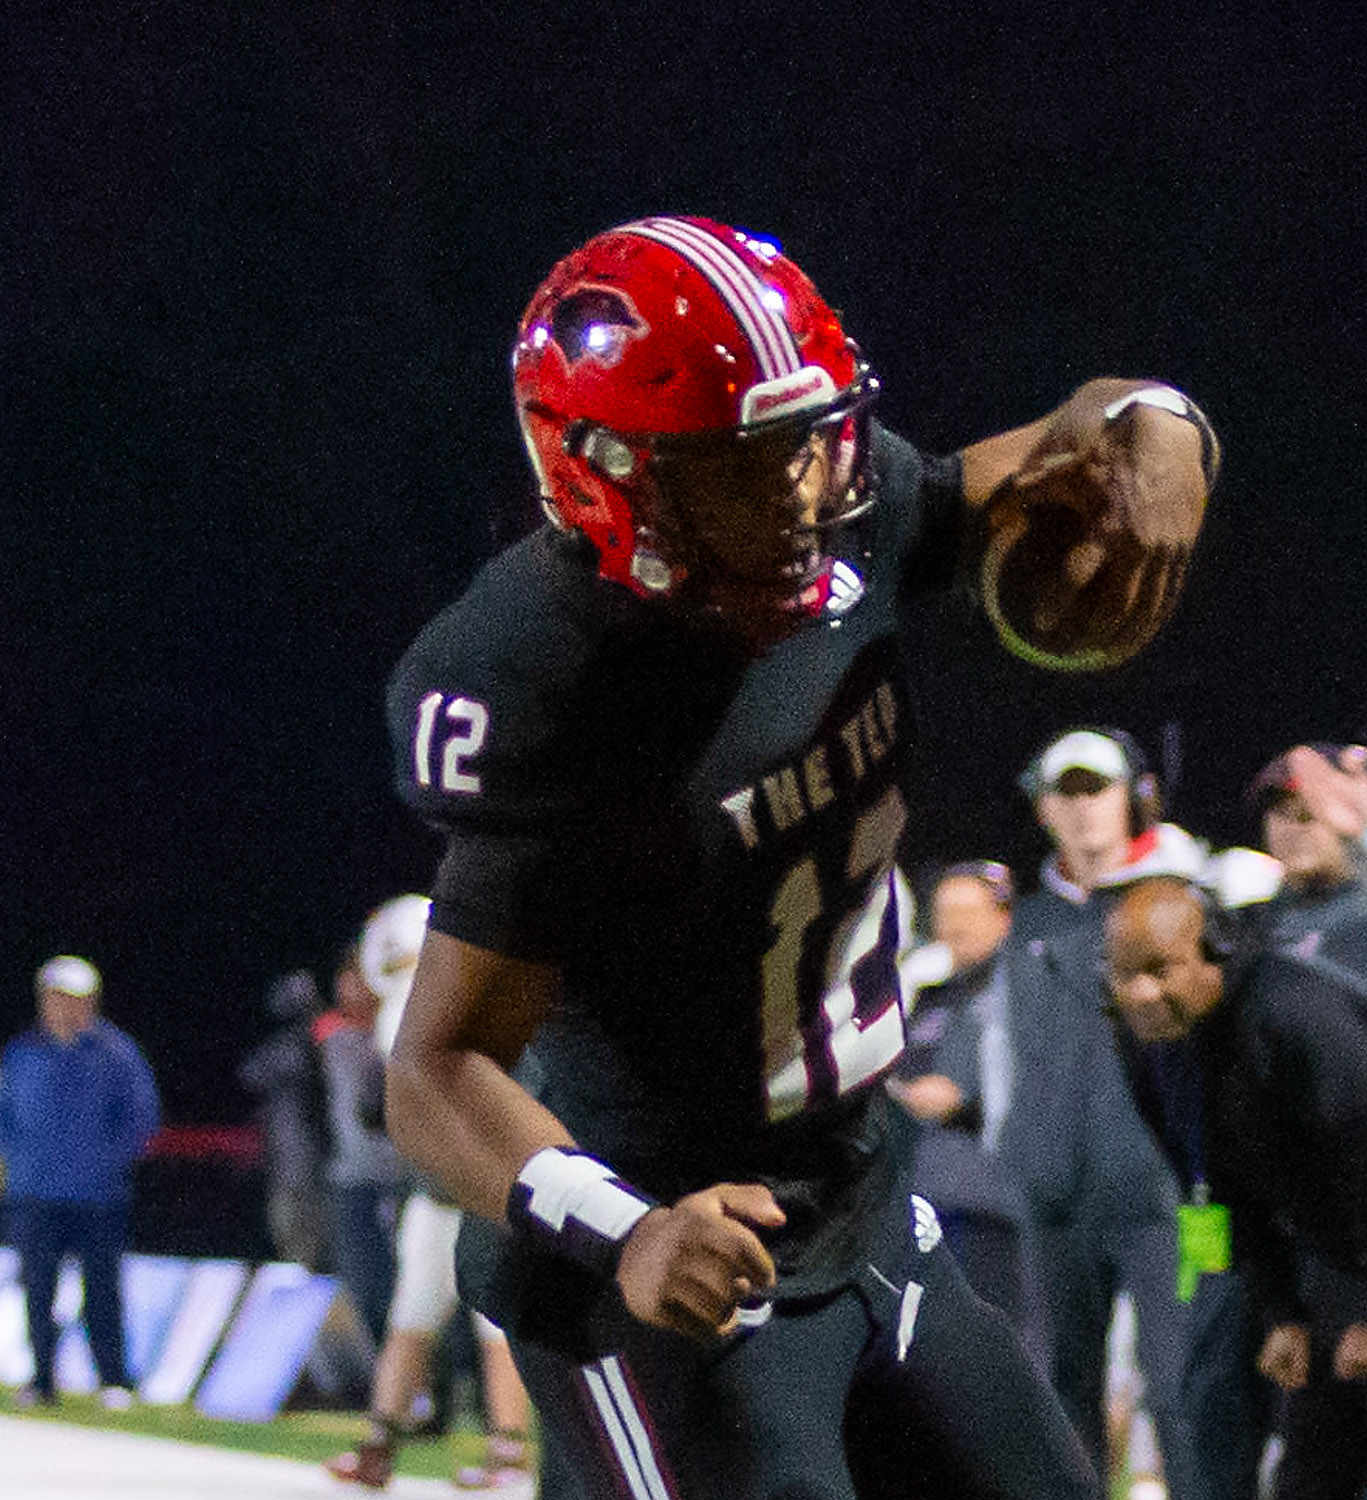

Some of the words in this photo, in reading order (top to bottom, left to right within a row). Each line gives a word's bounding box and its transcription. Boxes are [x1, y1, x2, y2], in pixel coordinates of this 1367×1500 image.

[415, 692, 489, 792] 12
[721, 746, 835, 849] THE
[761, 782, 909, 1122] 12
